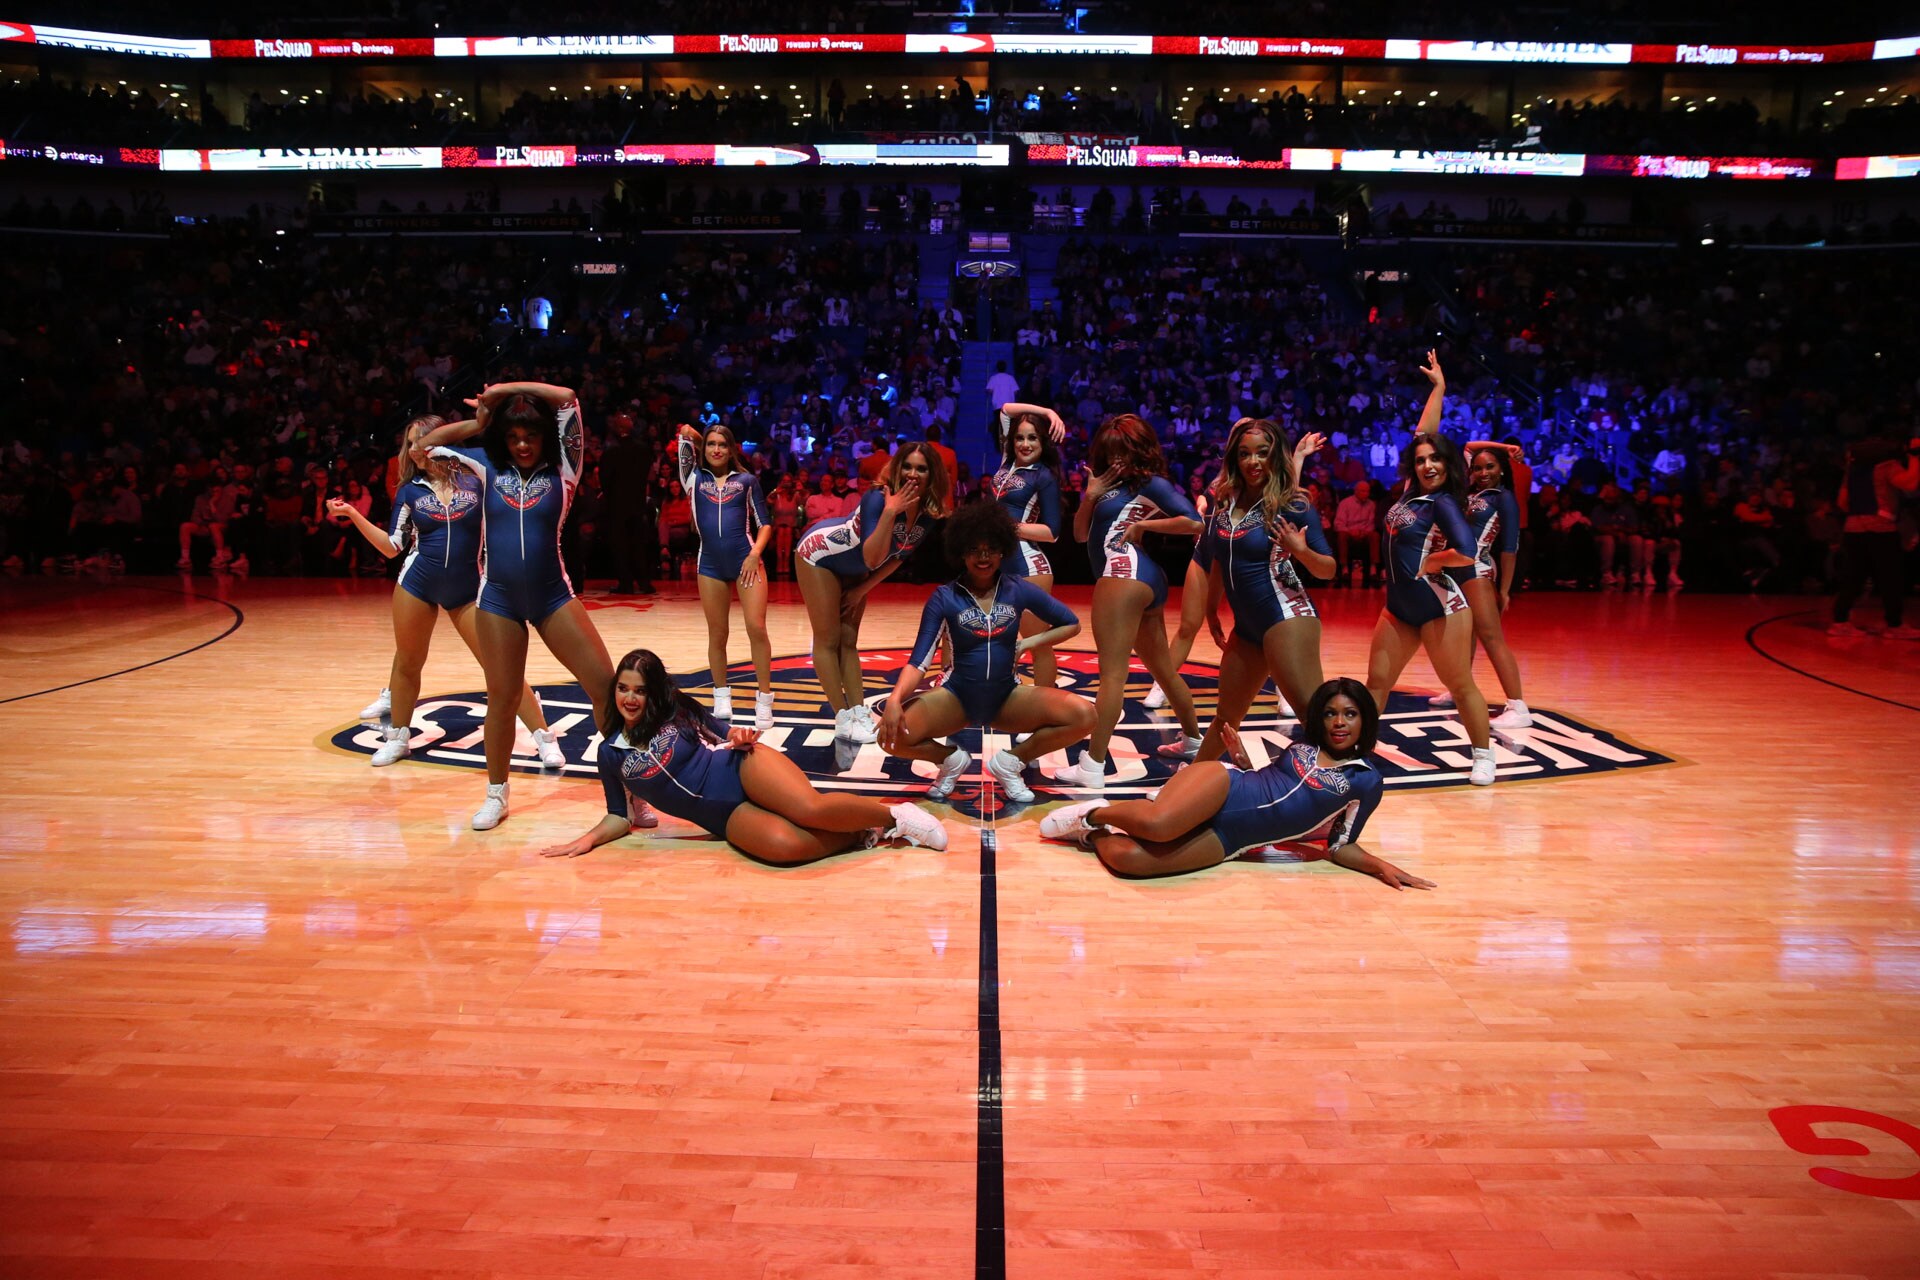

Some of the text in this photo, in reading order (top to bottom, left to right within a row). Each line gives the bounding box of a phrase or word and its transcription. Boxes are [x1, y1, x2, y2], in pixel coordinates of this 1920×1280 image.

[831, 40, 863, 50] entergy
[60, 151, 103, 164] entergy
[306, 160, 373, 170] FITNESS
[960, 608, 976, 624] NEW
